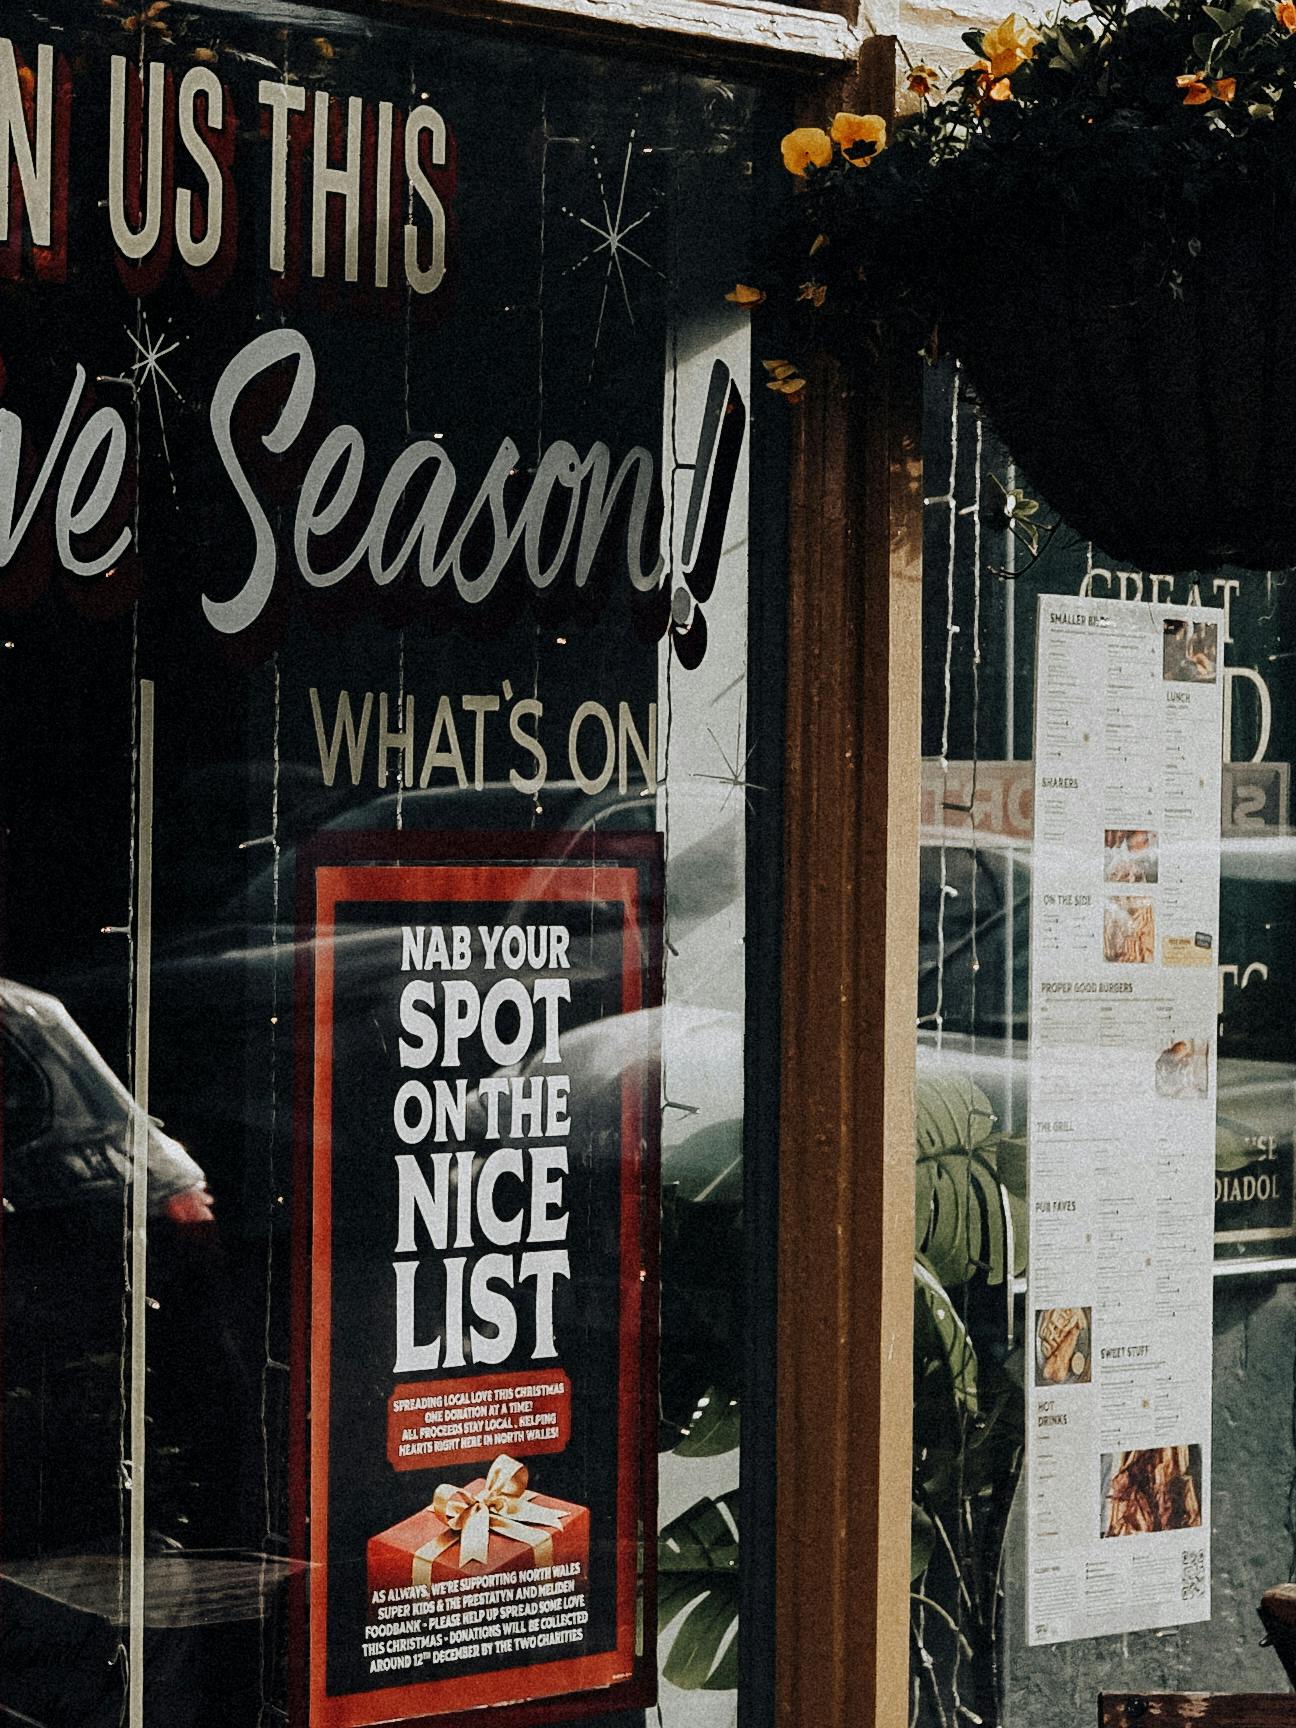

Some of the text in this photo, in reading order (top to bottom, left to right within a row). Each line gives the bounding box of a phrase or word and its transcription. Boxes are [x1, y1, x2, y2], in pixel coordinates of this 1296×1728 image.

[110, 55, 223, 267] US
[257, 80, 447, 295] THIS
[202, 328, 748, 672] Season!
[1050, 613, 1087, 627] SMALLER
[1166, 690, 1191, 703] LUNCH
[309, 682, 659, 795] WHAT'S ON
[1042, 778, 1079, 790] SHARERS
[401, 924, 571, 972] NAB YOUR
[1040, 981, 1134, 994] PROPER GOOD BURGERS
[398, 977, 572, 1070] SPOT
[393, 1074, 572, 1145] ON THE
[394, 1145, 571, 1254] NICE
[392, 1248, 572, 1374] LIST
[393, 1382, 565, 1413] SPREADING LOCAL LOVE THIS CHRISTMAS
[1037, 1400, 1054, 1413] HOT
[1037, 1413, 1068, 1427] DRINKS
[372, 1588, 386, 1604] AS
[432, 1580, 458, 1596] WE'RE
[459, 1572, 517, 1593] SUPPORTING
[519, 1566, 551, 1583] NORTH
[552, 1561, 581, 1578] WALES
[378, 1604, 411, 1621] SUPER
[412, 1600, 435, 1616] KIDS
[436, 1599, 445, 1613] &
[445, 1596, 461, 1611] THE
[462, 1588, 514, 1607] PRESTATYN
[515, 1584, 537, 1600] AND
[362, 1610, 589, 1657] THIS CHRISTMAS DONATIONS WILL BE COLLECTED
[364, 1594, 586, 1640] FOODBANK PLEASE HELP UP SPREAD SOME LOVE
[369, 1656, 412, 1674] AROUND
[432, 1644, 480, 1664] DECEMBER
[481, 1642, 493, 1656] BY
[494, 1638, 513, 1654] THE
[514, 1634, 537, 1651] TWO
[537, 1628, 584, 1647] CHARITIES
